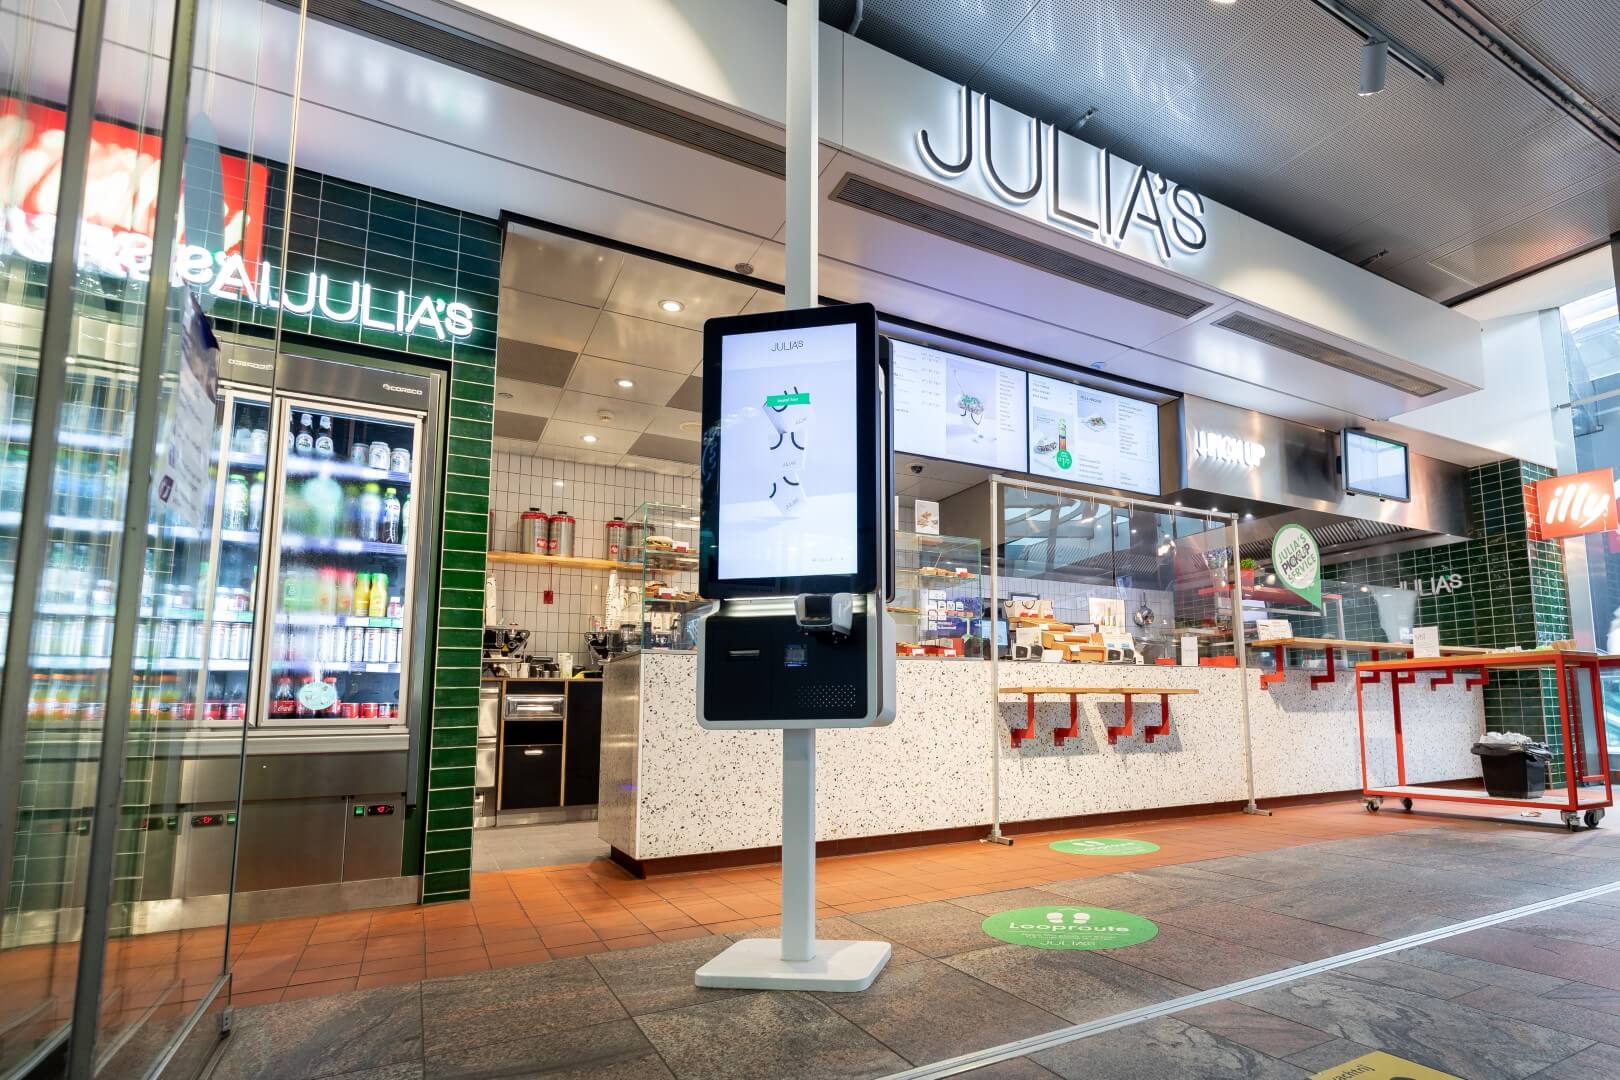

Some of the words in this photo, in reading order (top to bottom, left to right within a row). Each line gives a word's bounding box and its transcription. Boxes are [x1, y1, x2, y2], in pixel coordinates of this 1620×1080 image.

[915, 84, 1208, 263] JULIA'S
[282, 270, 474, 341] JULIA'S
[1545, 482, 1611, 528] illy
[1288, 553, 1317, 584] SERVICE
[1008, 921, 1130, 932] Looproute
[1332, 1064, 1376, 1080] achtrij
